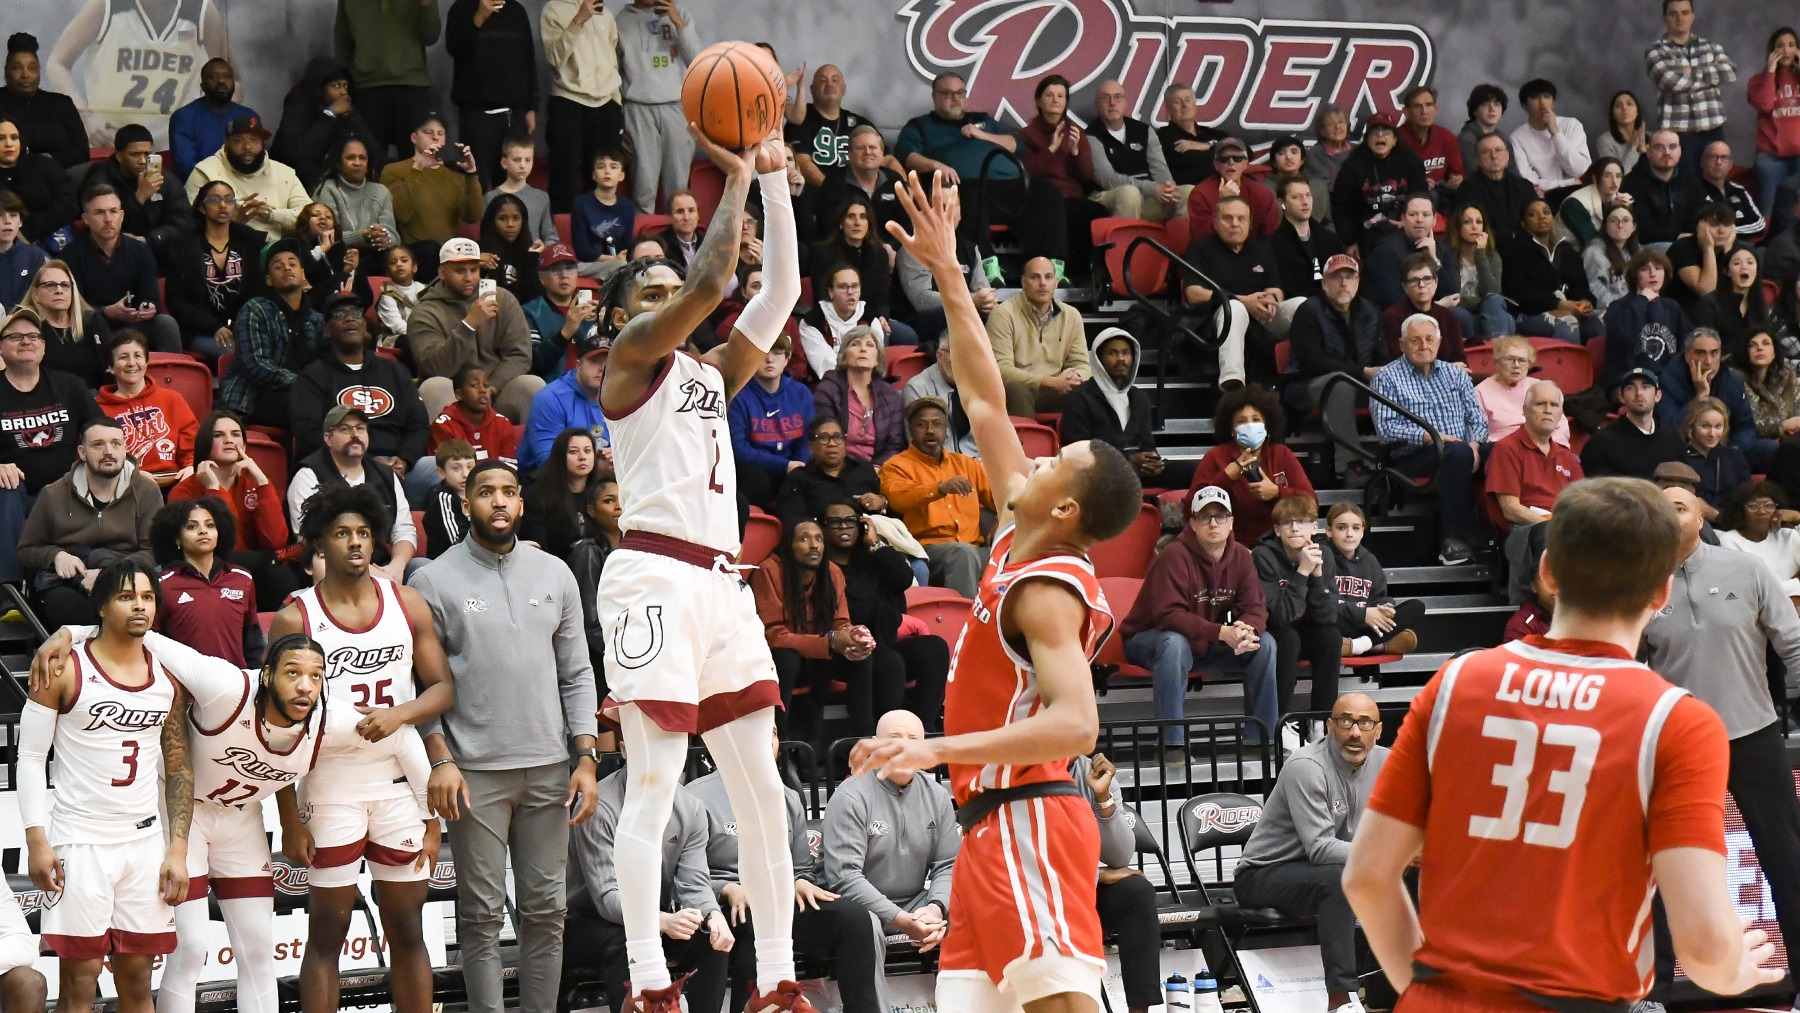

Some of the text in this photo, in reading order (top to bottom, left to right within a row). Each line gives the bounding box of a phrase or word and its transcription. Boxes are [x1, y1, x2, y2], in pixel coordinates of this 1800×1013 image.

[116, 47, 194, 74] RIDER
[653, 55, 669, 68] 99
[898, 0, 1437, 150] RIDER
[122, 74, 178, 115] 24
[0, 409, 70, 431] BRONCS
[220, 587, 244, 600] RIDER
[325, 644, 405, 680] RIDER
[350, 677, 395, 709] 35
[1495, 662, 1606, 711] LONG
[81, 700, 169, 733] RIDER
[111, 740, 140, 787] 3
[211, 746, 298, 782] RIDER
[1467, 715, 1602, 849] 33
[1192, 802, 1264, 834] RIDER
[272, 861, 309, 896] RID
[217, 933, 388, 966] o stngt
